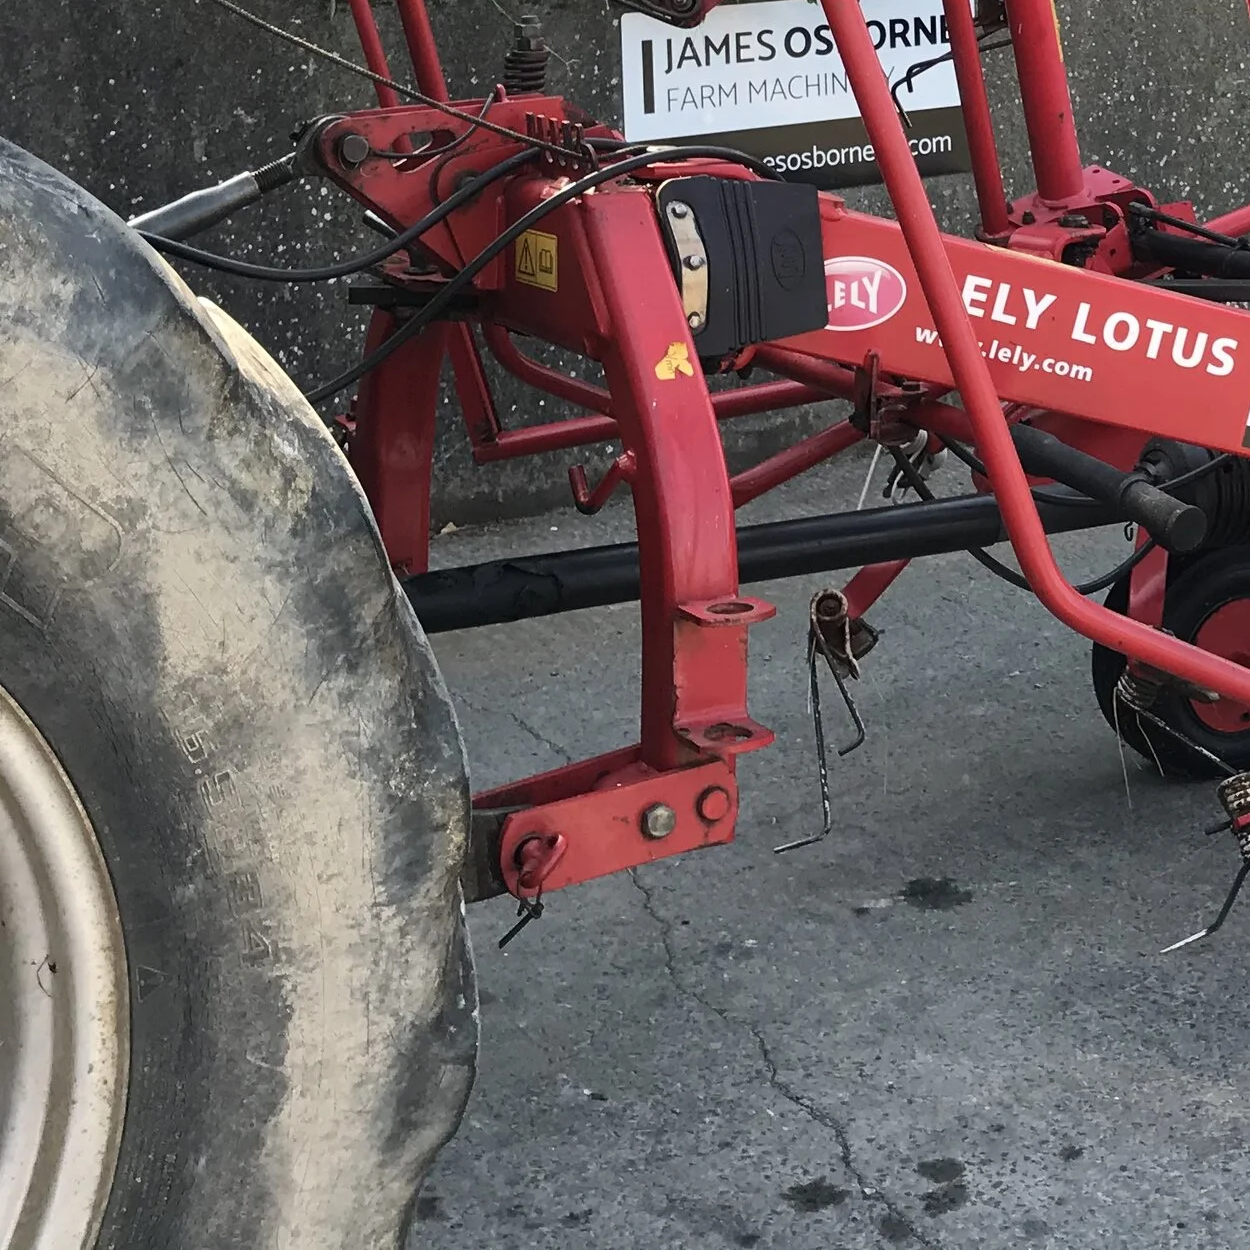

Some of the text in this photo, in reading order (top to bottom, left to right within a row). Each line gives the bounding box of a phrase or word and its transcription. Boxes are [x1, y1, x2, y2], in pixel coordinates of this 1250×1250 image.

[664, 15, 951, 75] JAMES OSORNE
[667, 65, 895, 113] FARM MACHINY
[827, 269, 882, 314] ELY
[961, 274, 1238, 377] ELY LOTUS
[915, 326, 1093, 382] w.lely.com
